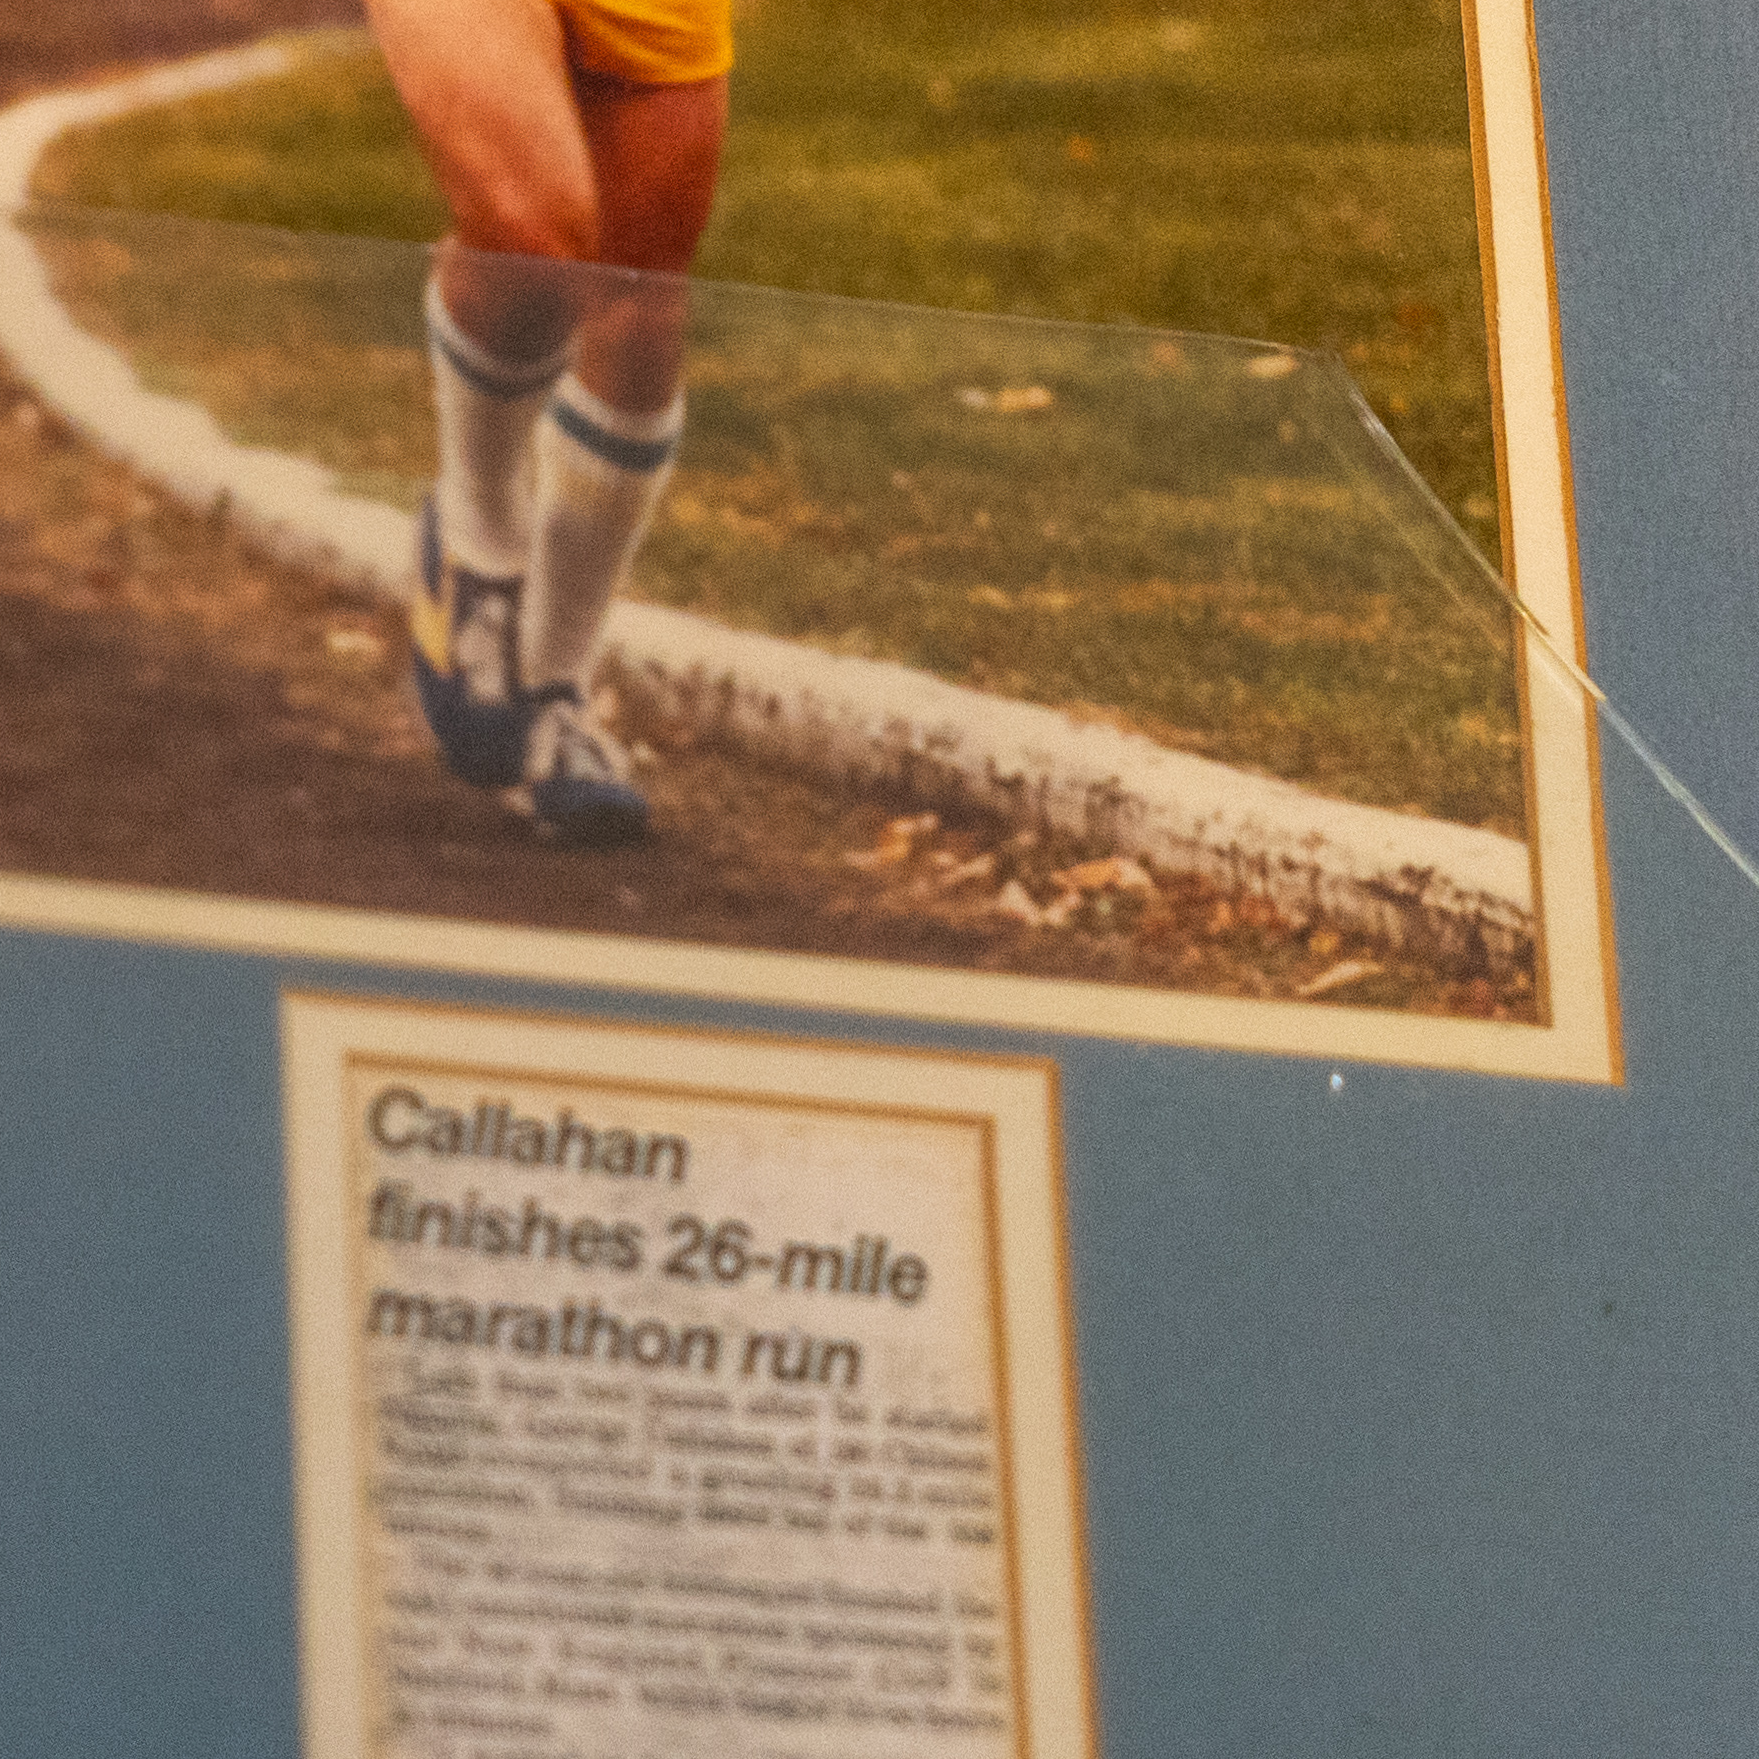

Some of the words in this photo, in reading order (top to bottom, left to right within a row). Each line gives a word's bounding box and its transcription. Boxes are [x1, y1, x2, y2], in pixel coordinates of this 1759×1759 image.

[369, 1088, 689, 1181] Callahan
[368, 1181, 643, 1271] finishes
[664, 1217, 929, 1306] 26-mile
[368, 1285, 723, 1373] marathon
[742, 1326, 861, 1387] run
